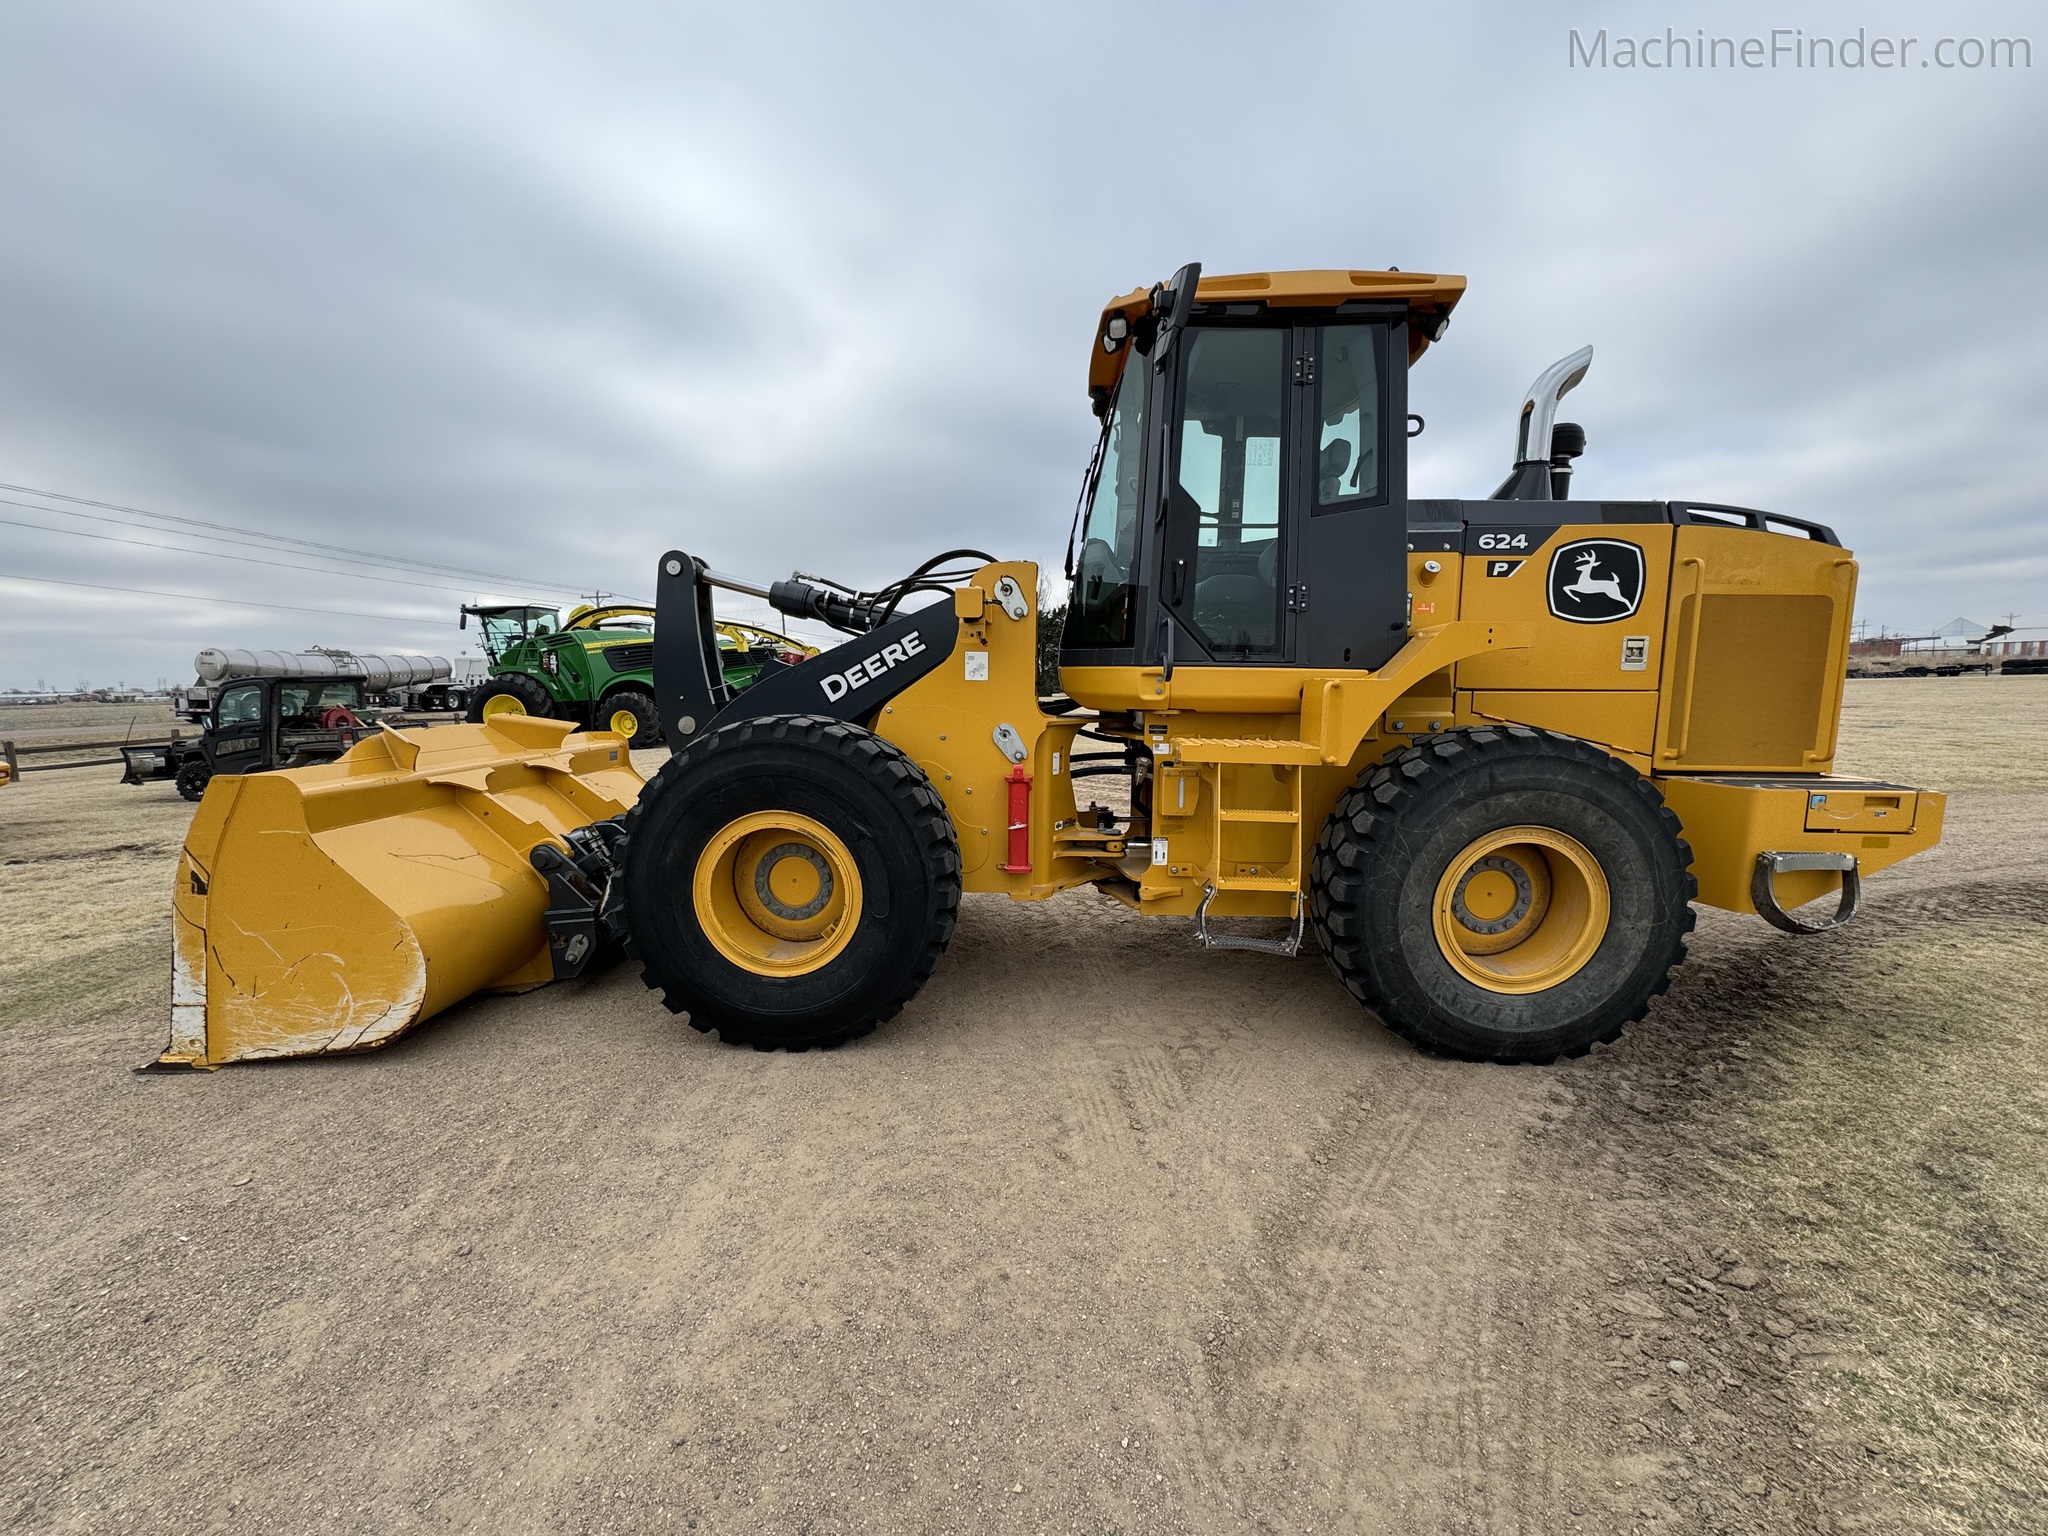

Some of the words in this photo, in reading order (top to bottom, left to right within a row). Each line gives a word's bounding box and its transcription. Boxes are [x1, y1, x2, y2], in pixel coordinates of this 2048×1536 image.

[1478, 533, 1528, 550] 624
[1492, 562, 1509, 576] P
[819, 631, 926, 702] DEERE
